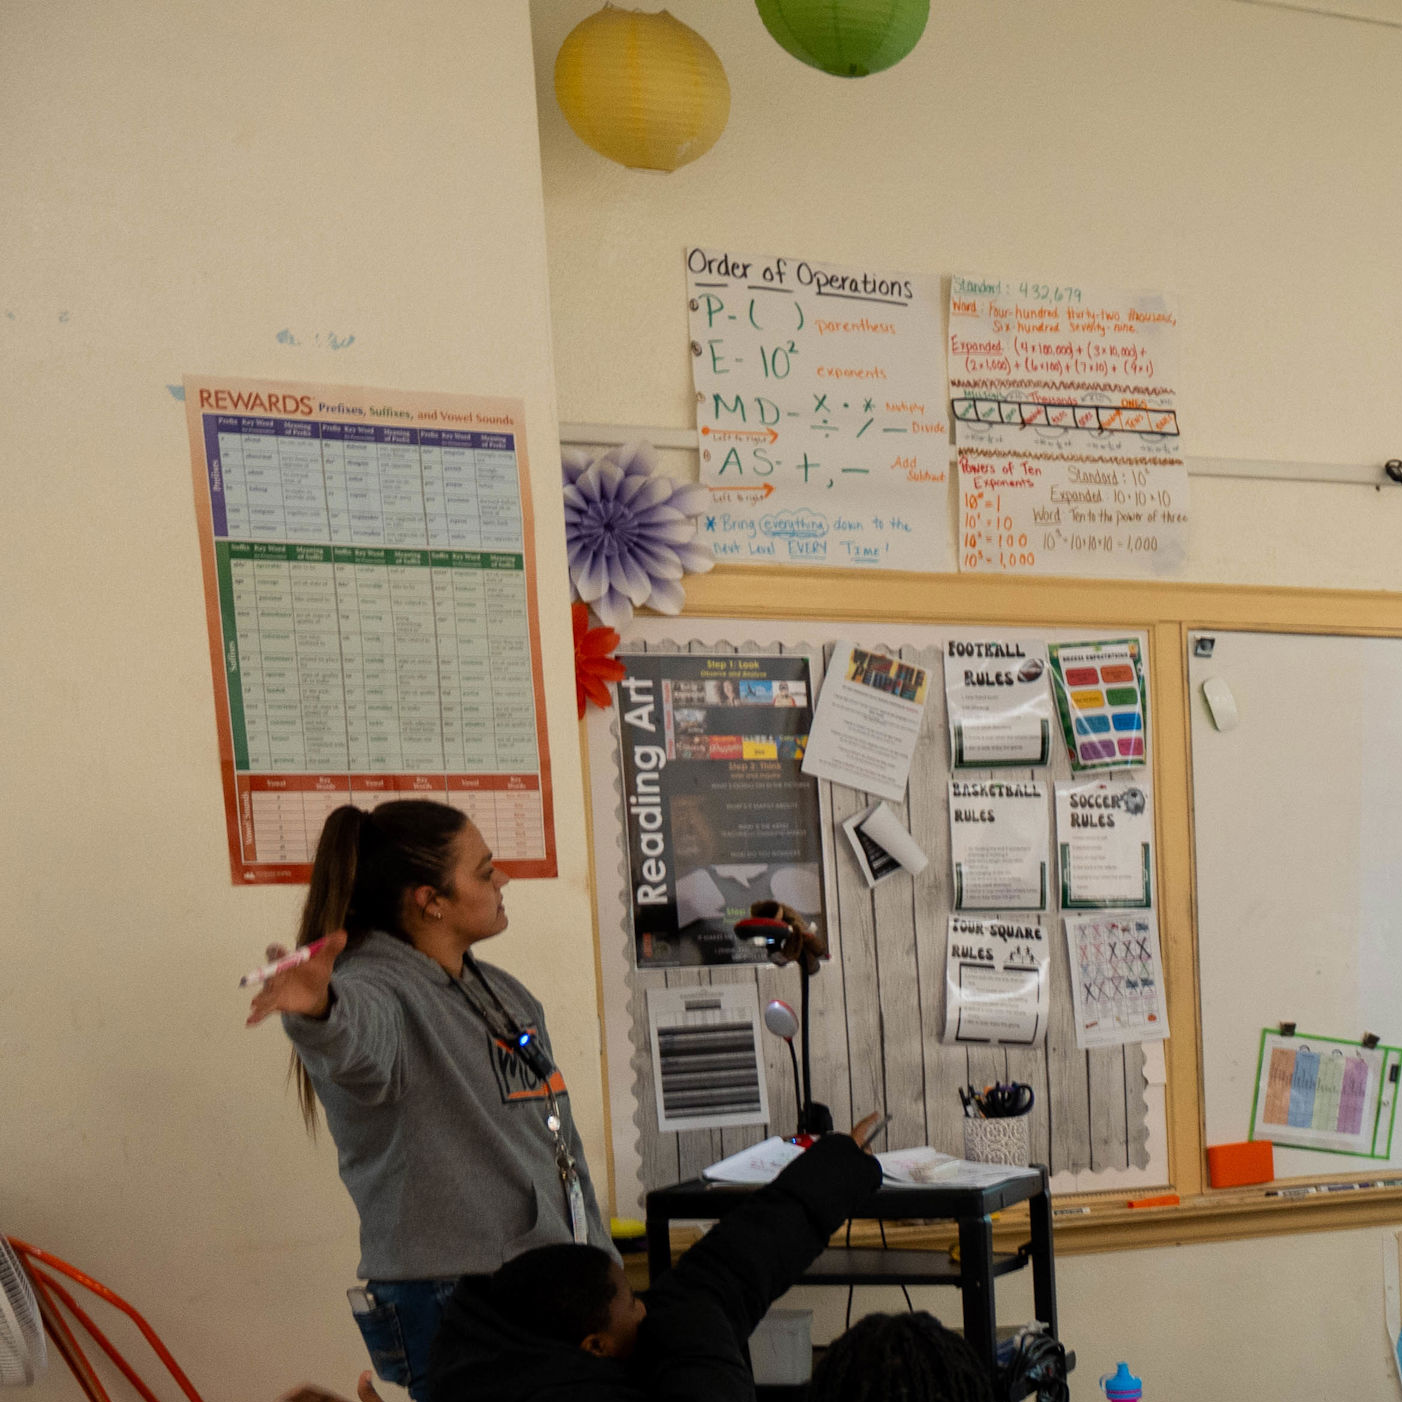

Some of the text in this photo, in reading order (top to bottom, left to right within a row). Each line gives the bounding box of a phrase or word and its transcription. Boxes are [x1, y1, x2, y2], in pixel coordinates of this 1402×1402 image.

[688, 248, 913, 299] Order of Operations
[1019, 281, 1082, 304] 432,679
[814, 318, 896, 335] parenthesis
[817, 366, 887, 379] exponents
[199, 388, 514, 425] REWARDS Prefixes, Suffixes, and Vowel Sounds
[912, 421, 946, 434] Divide
[891, 456, 917, 469] Add
[959, 457, 1042, 476] Powers of Ten
[906, 469, 946, 482] Subtract
[973, 477, 1034, 490] Exponents
[1071, 509, 1085, 522] Ten
[1100, 509, 1113, 522] the
[1116, 509, 1143, 526] power
[1147, 509, 1157, 522] of
[1163, 508, 1188, 522] three
[720, 513, 912, 538] Bring everything down to the
[788, 541, 827, 555] EVERY
[948, 640, 1026, 658] FOOTBALL
[707, 660, 760, 670] Step Look
[964, 669, 1014, 686] RULES
[622, 675, 668, 906] Reading Art
[952, 782, 1041, 797] BASKETBALL
[1070, 793, 1121, 808] SOCCER
[955, 808, 995, 822] RULES
[1070, 813, 1115, 827] RULES
[990, 924, 1042, 942] SQUARE
[952, 944, 994, 960] RULES
